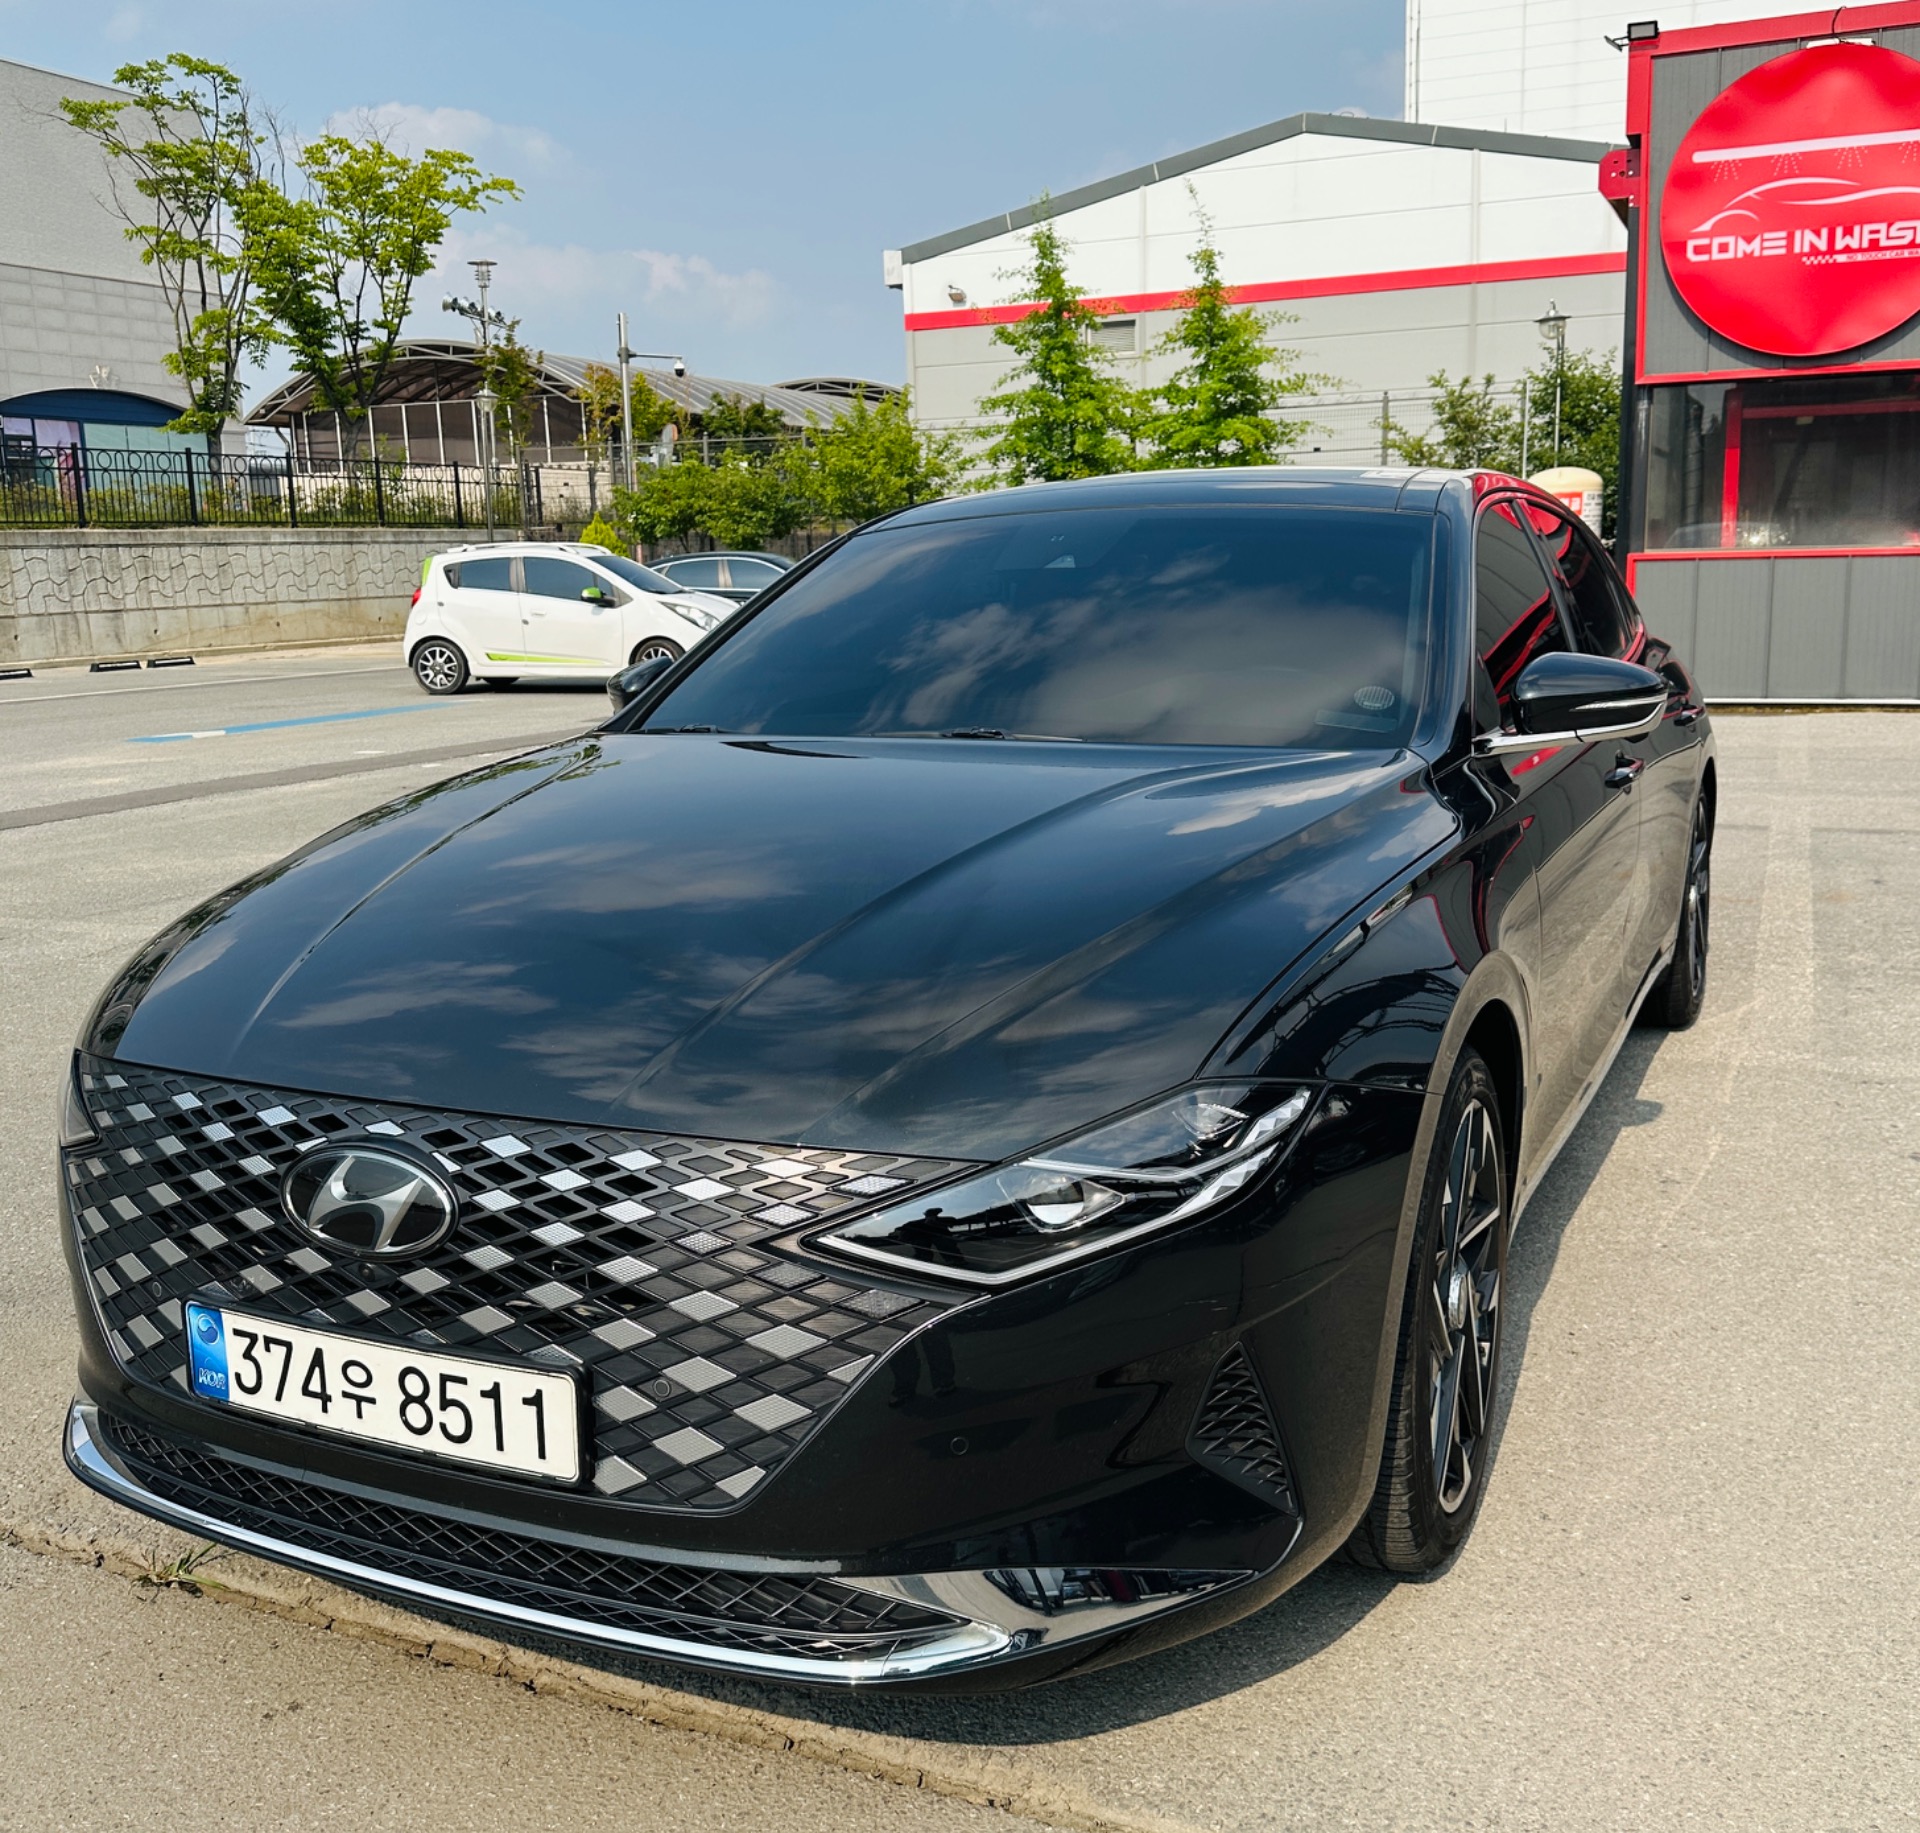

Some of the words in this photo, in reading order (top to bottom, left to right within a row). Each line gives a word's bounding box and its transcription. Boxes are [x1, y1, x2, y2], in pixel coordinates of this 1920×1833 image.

[1686, 230, 1787, 262] COME
[1794, 227, 1828, 254] IN
[1834, 219, 1920, 251] WAS
[198, 1367, 226, 1390] KOR
[232, 1328, 377, 1419] 374우
[398, 1366, 547, 1460] 8511
